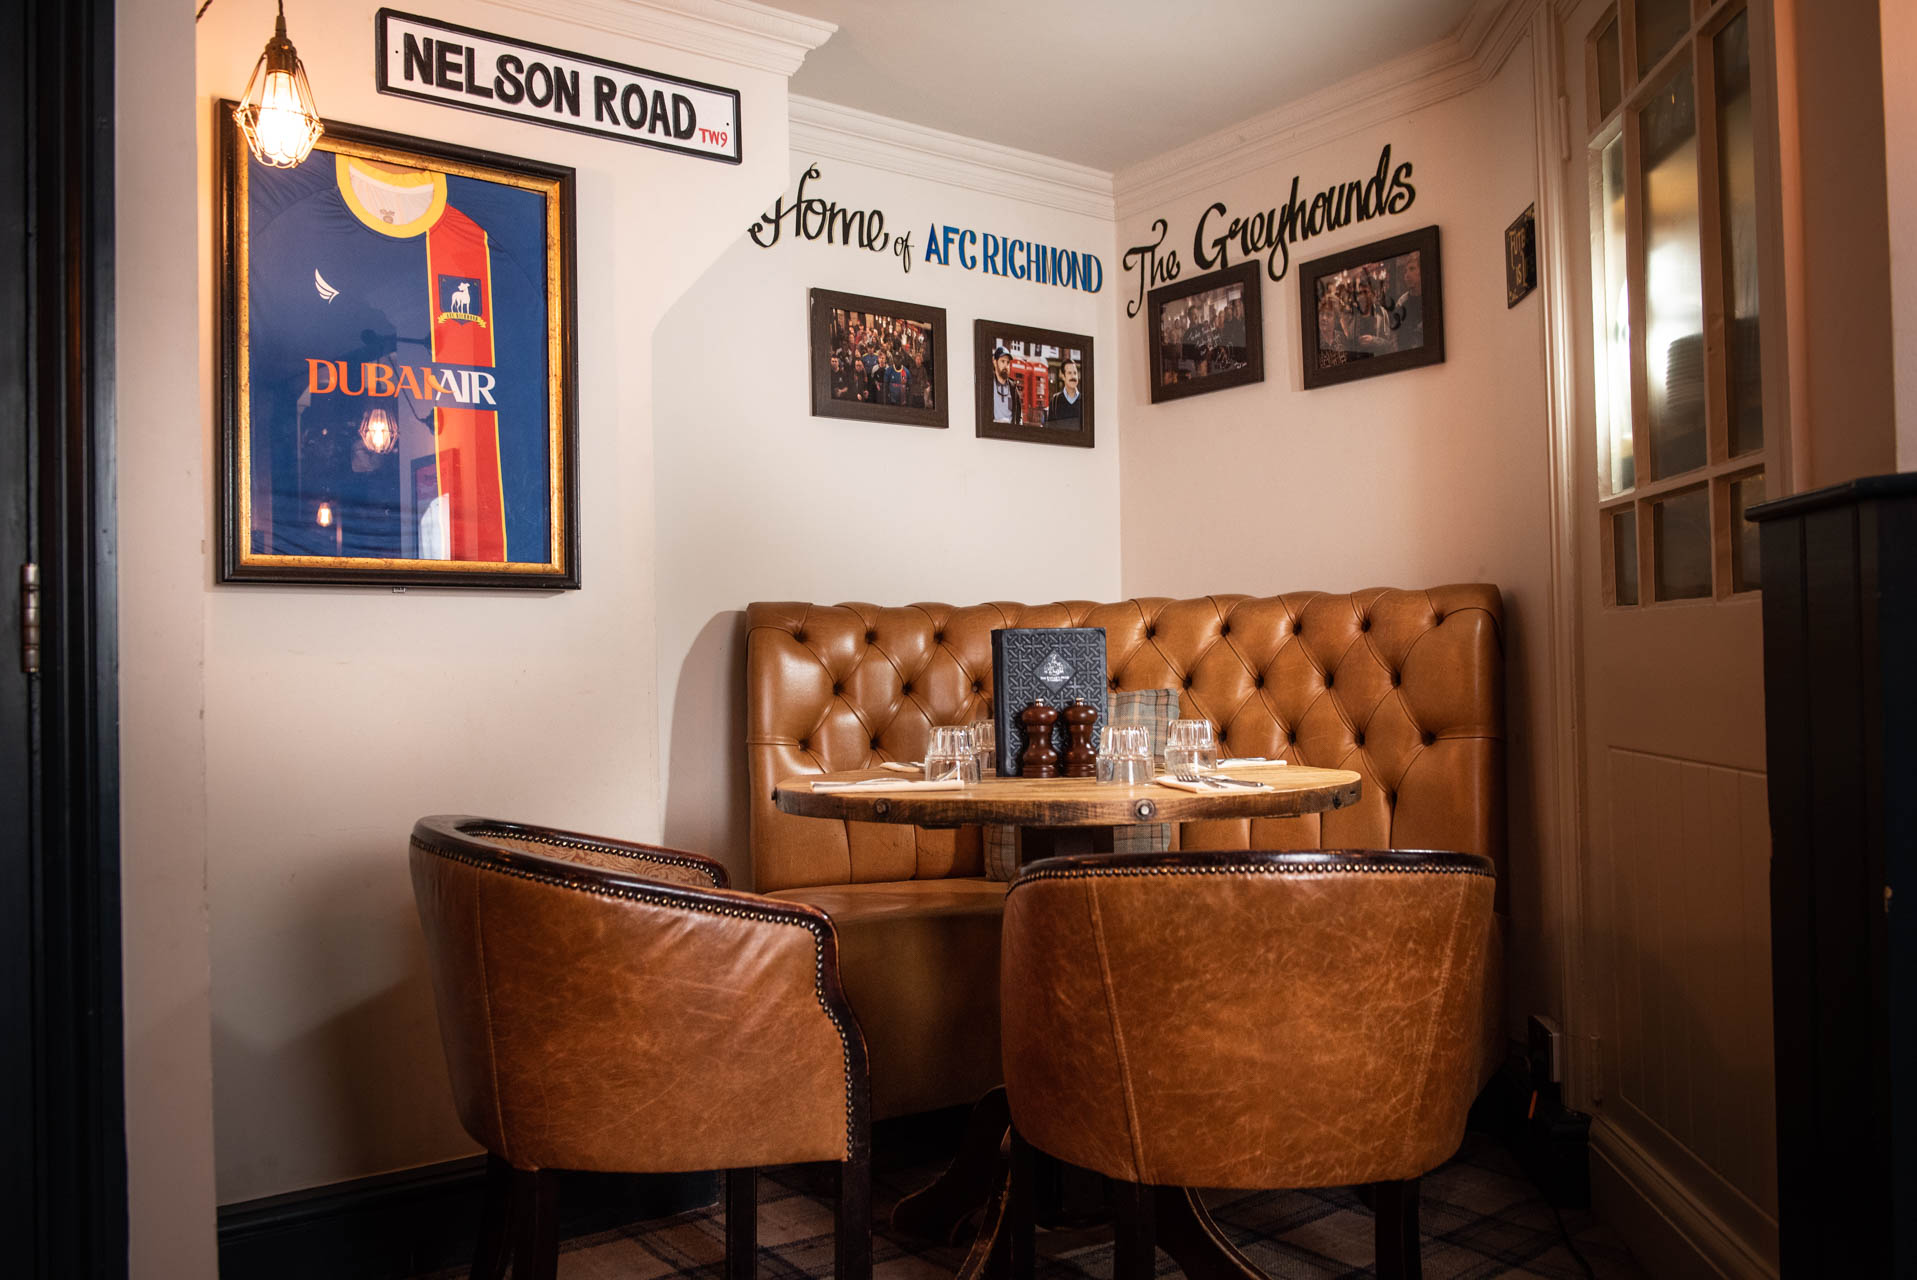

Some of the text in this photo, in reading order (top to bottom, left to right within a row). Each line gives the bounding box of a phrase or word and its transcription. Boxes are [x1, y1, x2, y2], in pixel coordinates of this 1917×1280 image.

[403, 32, 697, 141] NELSON ROAD
[698, 127, 728, 148] TW9
[747, 161, 1103, 294] Home of AFC RICHMOND
[1122, 143, 1416, 318] The Greyhounds
[305, 358, 497, 405] DUBAI AIR
